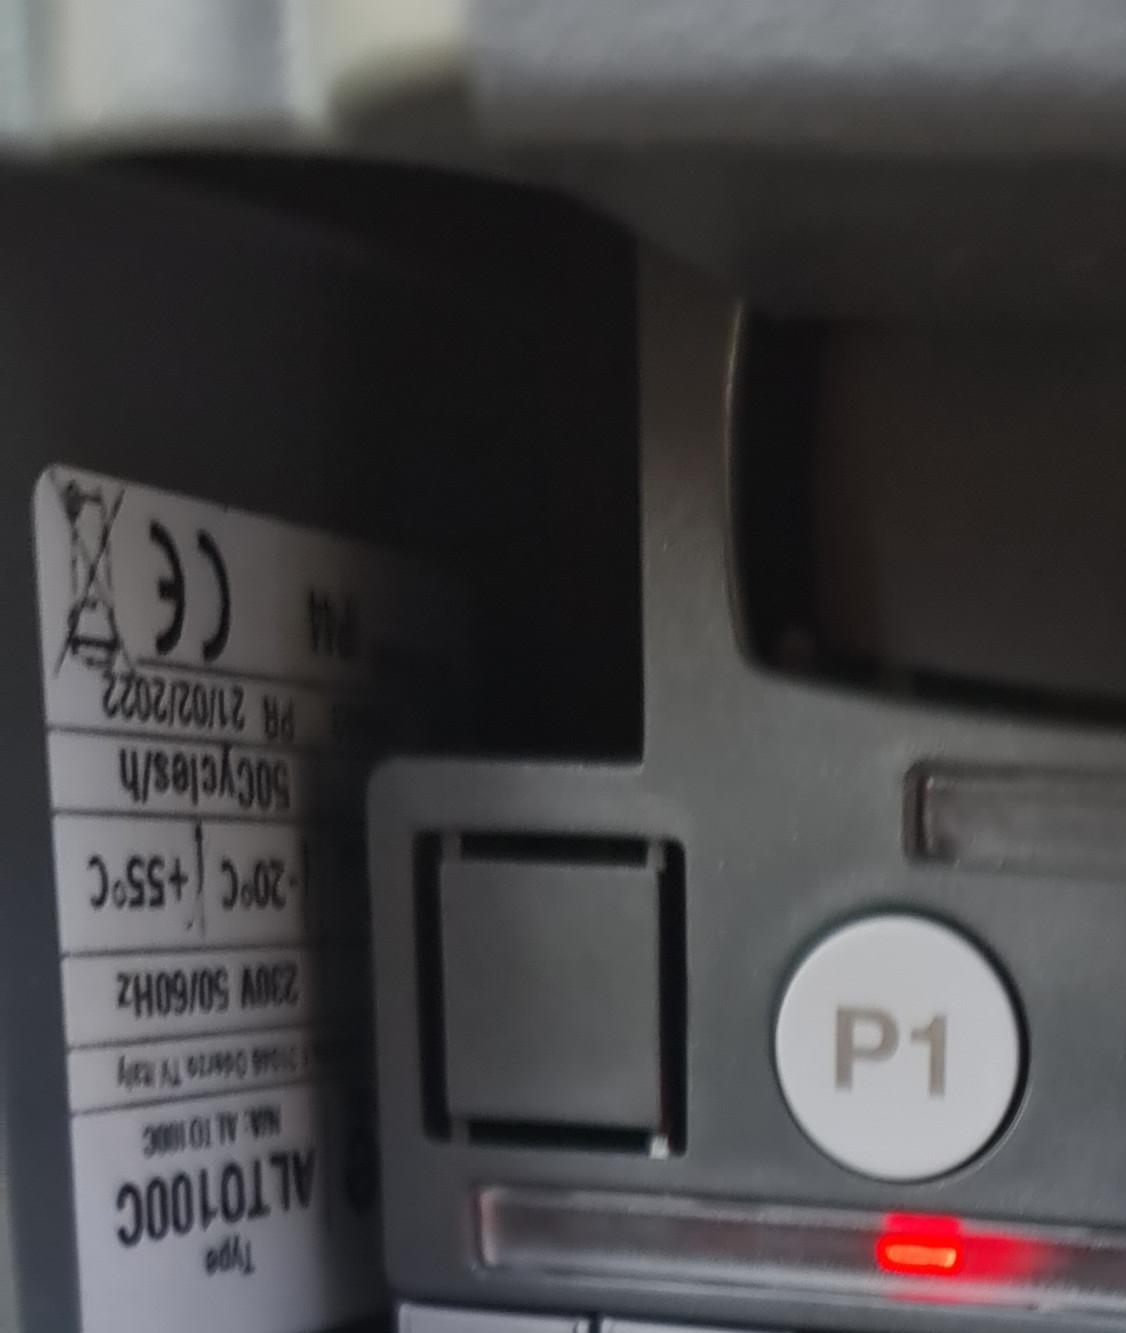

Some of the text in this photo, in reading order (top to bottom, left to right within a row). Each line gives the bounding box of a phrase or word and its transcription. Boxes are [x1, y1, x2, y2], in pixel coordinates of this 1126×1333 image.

[103, 672, 245, 732] 21/02/2022
[119, 744, 290, 810] 50Cycles/h
[115, 961, 299, 1019] 230V 50/60Hz
[833, 1005, 948, 1097] P1
[116, 1147, 318, 1249] ALTO100C
[206, 1233, 257, 1276] Type
